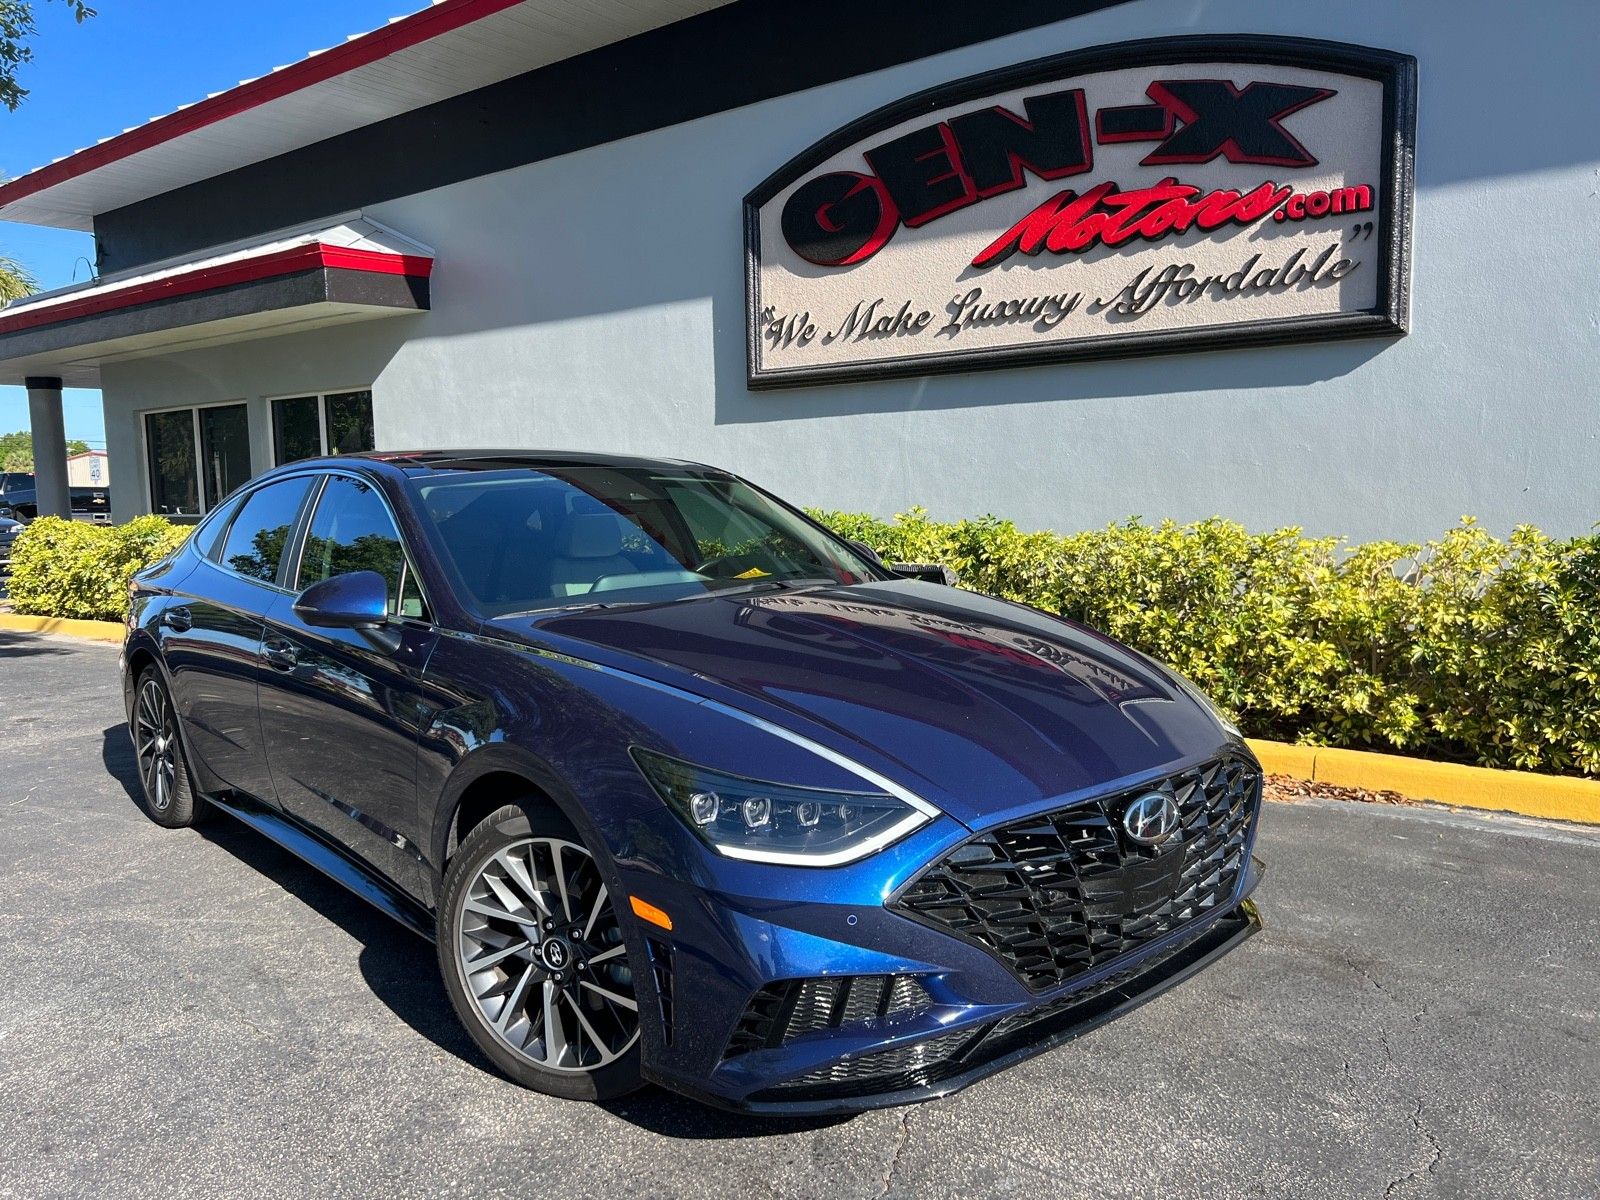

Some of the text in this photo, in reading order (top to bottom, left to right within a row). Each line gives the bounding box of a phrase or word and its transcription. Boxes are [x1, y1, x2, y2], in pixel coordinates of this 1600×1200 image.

[781, 79, 1338, 267] GEN-X
[826, 298, 936, 343] Make
[941, 287, 1087, 336] Luxury
[91, 469, 101, 478] 40
